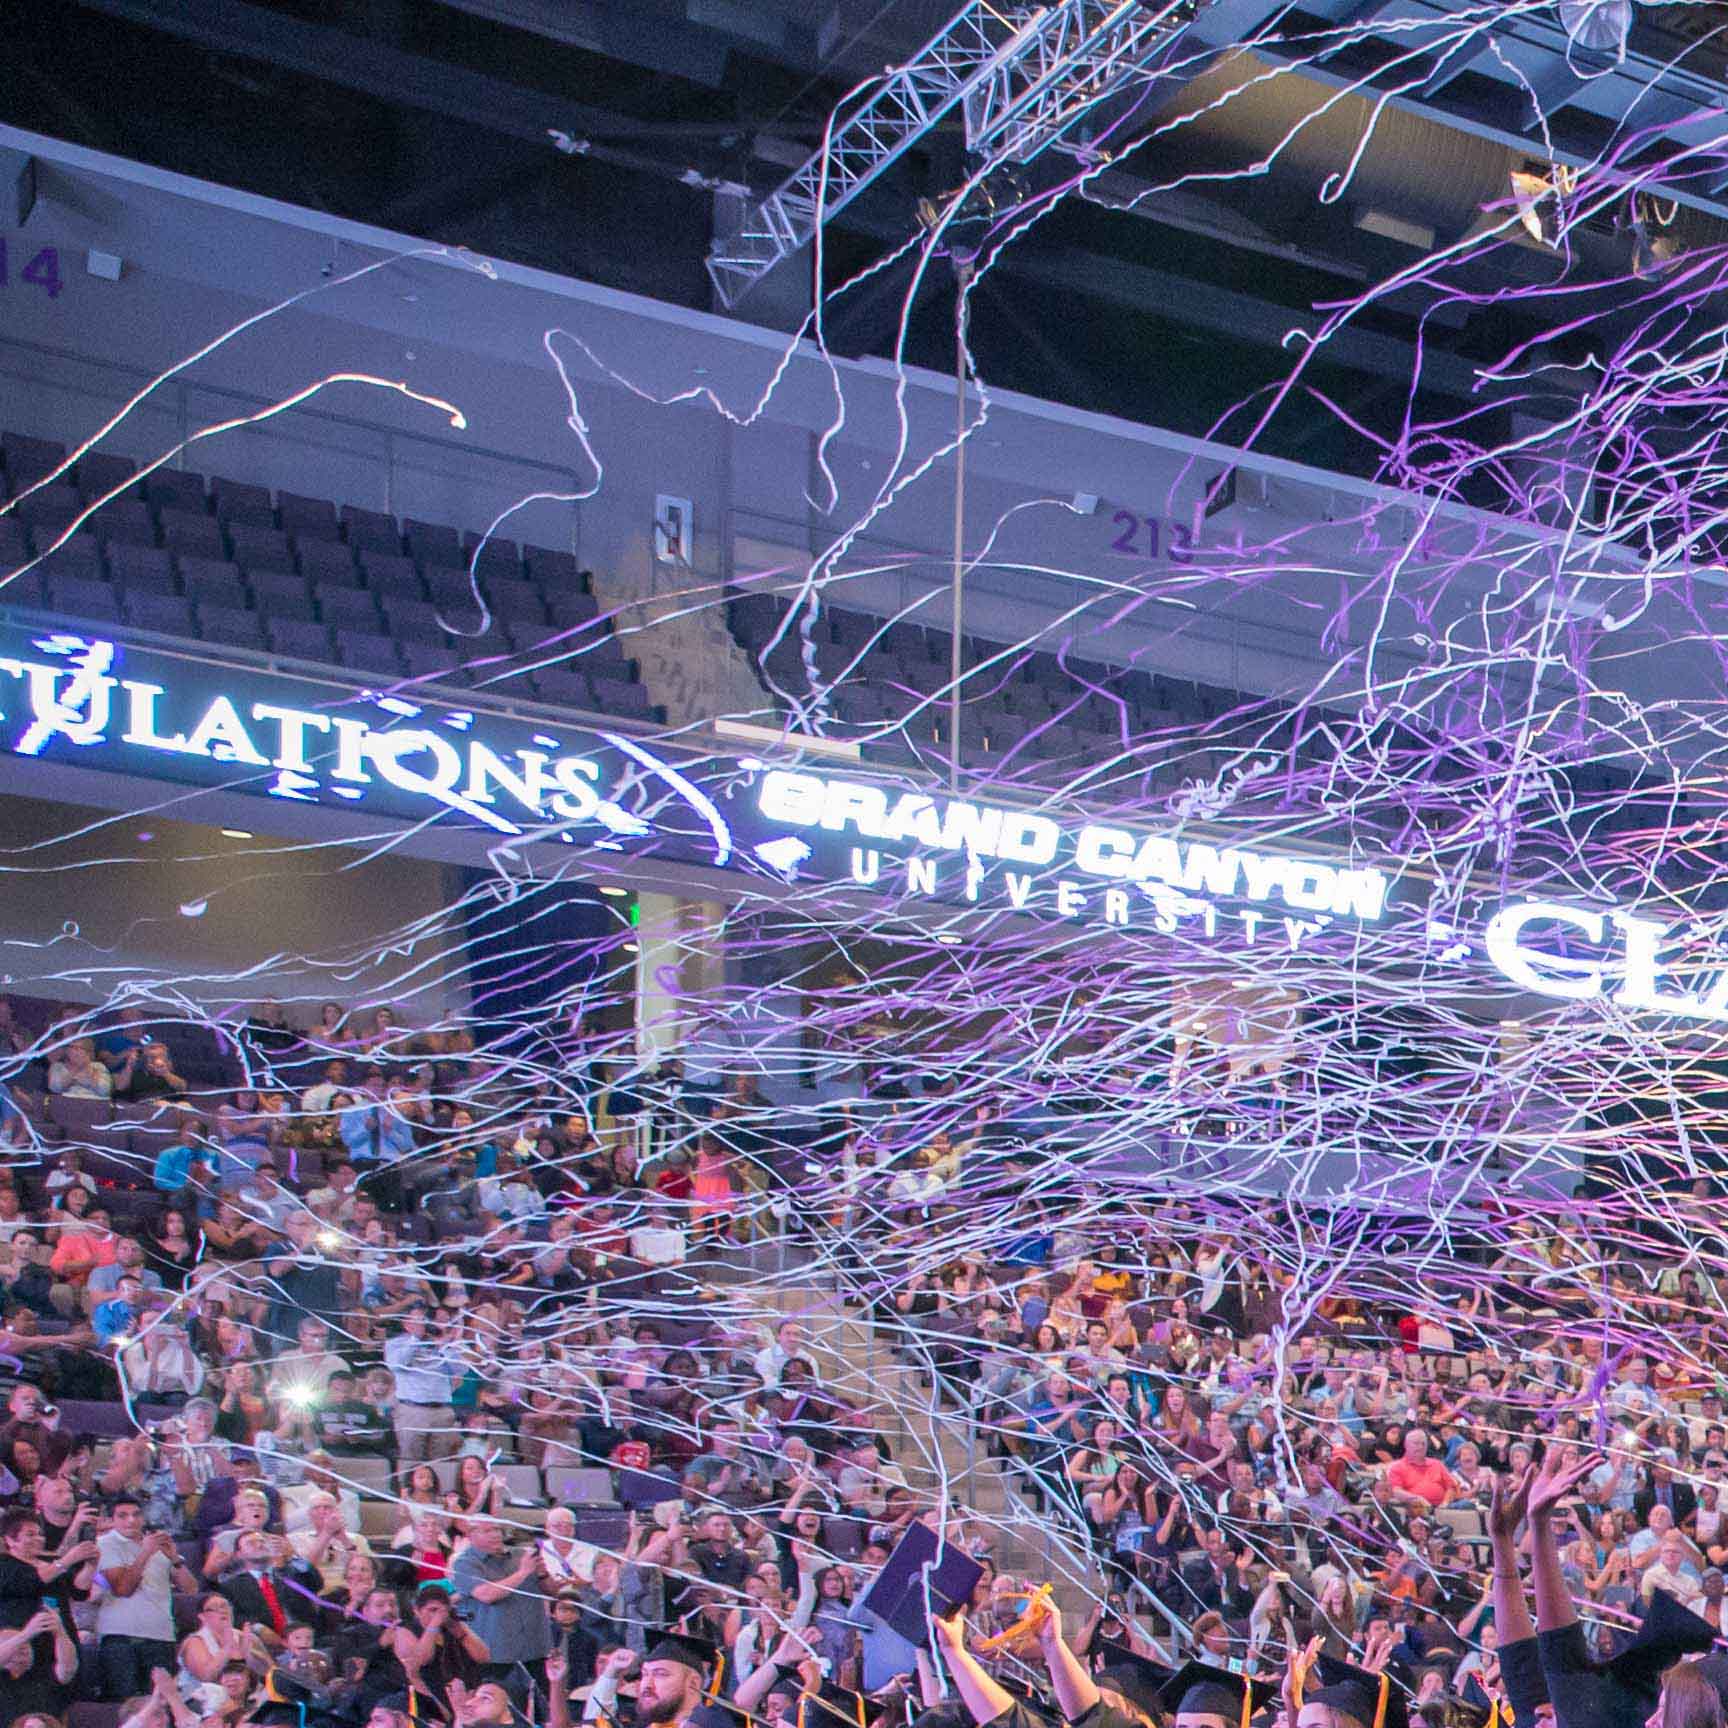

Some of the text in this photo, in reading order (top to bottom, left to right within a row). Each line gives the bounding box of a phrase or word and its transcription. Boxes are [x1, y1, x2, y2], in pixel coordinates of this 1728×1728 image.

[759, 770, 1387, 921] GRAND CANYON
[851, 847, 1305, 952] UNIVERSITY
